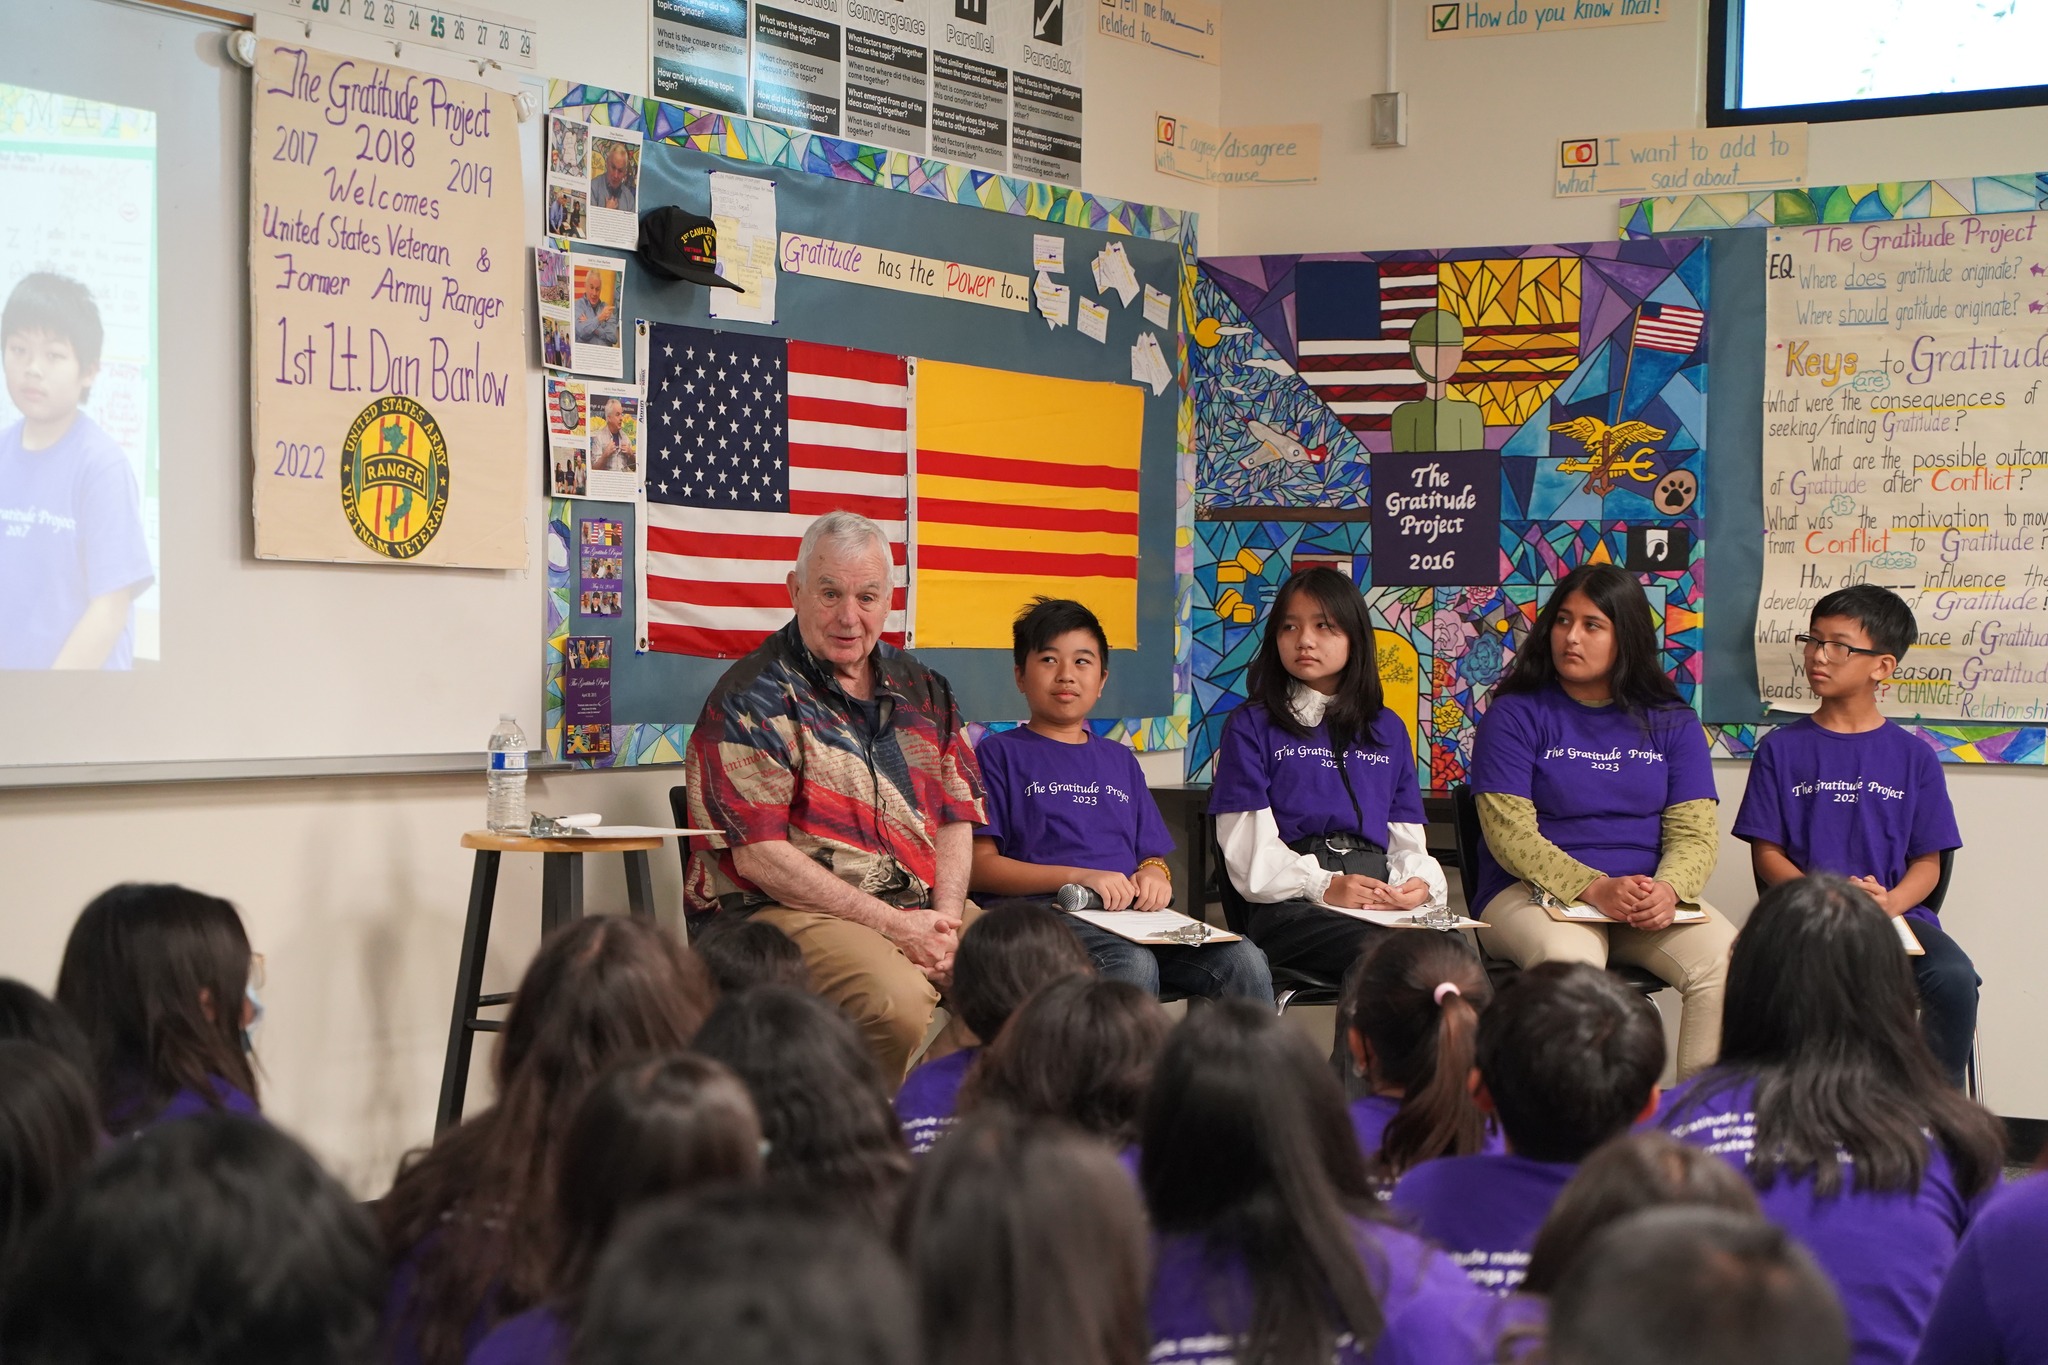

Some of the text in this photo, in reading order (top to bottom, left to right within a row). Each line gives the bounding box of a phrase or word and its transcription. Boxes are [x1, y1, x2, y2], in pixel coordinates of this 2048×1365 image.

[364, 0, 375, 22] 22
[384, 4, 395, 25] 23
[409, 9, 420, 31] 24
[430, 14, 445, 39] 25
[454, 20, 465, 41] 26
[477, 26, 488, 46] 27
[500, 30, 510, 50] 28
[520, 34, 531, 56] 29
[759, 13, 830, 40] What was the significance
[846, 0, 926, 36] Convergence
[1101, 11, 1151, 44] related to
[1143, 0, 1214, 36] me how is
[1465, 1, 1501, 29] How
[1506, 0, 1528, 27] do
[1534, 6, 1565, 30] you
[1574, 0, 1613, 20] know
[946, 24, 995, 54] Parallel
[1023, 45, 1072, 75] Paradox
[657, 67, 671, 77] How
[672, 73, 684, 81] and
[684, 76, 698, 85] why
[698, 77, 708, 86] did
[720, 83, 735, 92] topic
[657, 78, 678, 91] begin?
[267, 46, 491, 147] The Gratitude Project
[1178, 124, 1188, 150] I
[1604, 130, 1790, 166] I want to add to
[272, 123, 493, 198] 2017 2018 2019
[1156, 149, 1260, 184] with because
[323, 166, 440, 220] Welcomes
[1557, 162, 1739, 195] what said about
[262, 202, 491, 272] United States Veteran &
[1802, 215, 2038, 263] The Gratitude Project
[784, 235, 862, 274] Gratitude
[877, 252, 901, 280] has
[909, 256, 935, 287] the
[945, 261, 996, 299] Power
[1799, 263, 1839, 291] Where
[1844, 262, 1887, 288] does
[1896, 257, 1953, 293] gratitude
[1961, 256, 2023, 289] originate?
[274, 253, 504, 329] Former Army Ranger
[1796, 292, 2022, 330] Where should gratitude originate?
[275, 316, 317, 386] 1st
[323, 321, 362, 392] Lt.
[370, 328, 420, 396] Dan
[429, 336, 509, 407] Barlow
[1786, 339, 1859, 388] Keys
[1880, 348, 1905, 374] to
[1855, 374, 1885, 388] are
[1763, 380, 2043, 416] What were the consequences of
[345, 397, 448, 468] UNITED STATES ARMY
[1768, 413, 1877, 444] seeking/finding
[273, 440, 326, 480] 2022
[1812, 445, 1843, 471] What
[1852, 454, 1876, 470] are
[1881, 445, 1901, 469] the
[1913, 441, 1987, 476] possible
[366, 464, 425, 488] RANGER
[1411, 462, 1450, 488] The
[1770, 471, 1785, 495] of
[1790, 470, 1866, 505] Gratitude
[1883, 469, 1923, 494] after
[1385, 484, 1477, 517] Gratitude
[1837, 498, 1848, 512] is
[341, 481, 447, 559] VIETNAM VETERAN
[1400, 514, 1465, 544] Project
[1766, 505, 1799, 531] What
[1807, 514, 1833, 530] was
[1858, 504, 1877, 529] the
[1892, 502, 1989, 529] motivation
[2004, 504, 2017, 526] to
[1768, 532, 1795, 554] from
[1805, 528, 1891, 554] Conflict
[1911, 531, 1926, 552] to
[1409, 551, 1456, 570] 2016
[1800, 563, 1832, 589] How
[1840, 563, 1867, 587] did
[1924, 562, 2006, 588] influence
[1877, 557, 1912, 569] does
[1758, 620, 1793, 643] What
[1962, 620, 1982, 646] of
[1892, 666, 1952, 681] eason
[1763, 676, 1966, 706] leads CHANGE?
[1274, 744, 1390, 764] The Gratitue Project
[1544, 745, 1564, 760] The
[1567, 746, 1622, 761] Gratitude
[1591, 761, 1620, 773] 2023
[1024, 781, 1046, 797] The
[1048, 781, 1100, 795] Gratitude
[1072, 795, 1098, 806] 2023
[1792, 781, 1813, 797] The
[1867, 781, 1905, 801] Project
